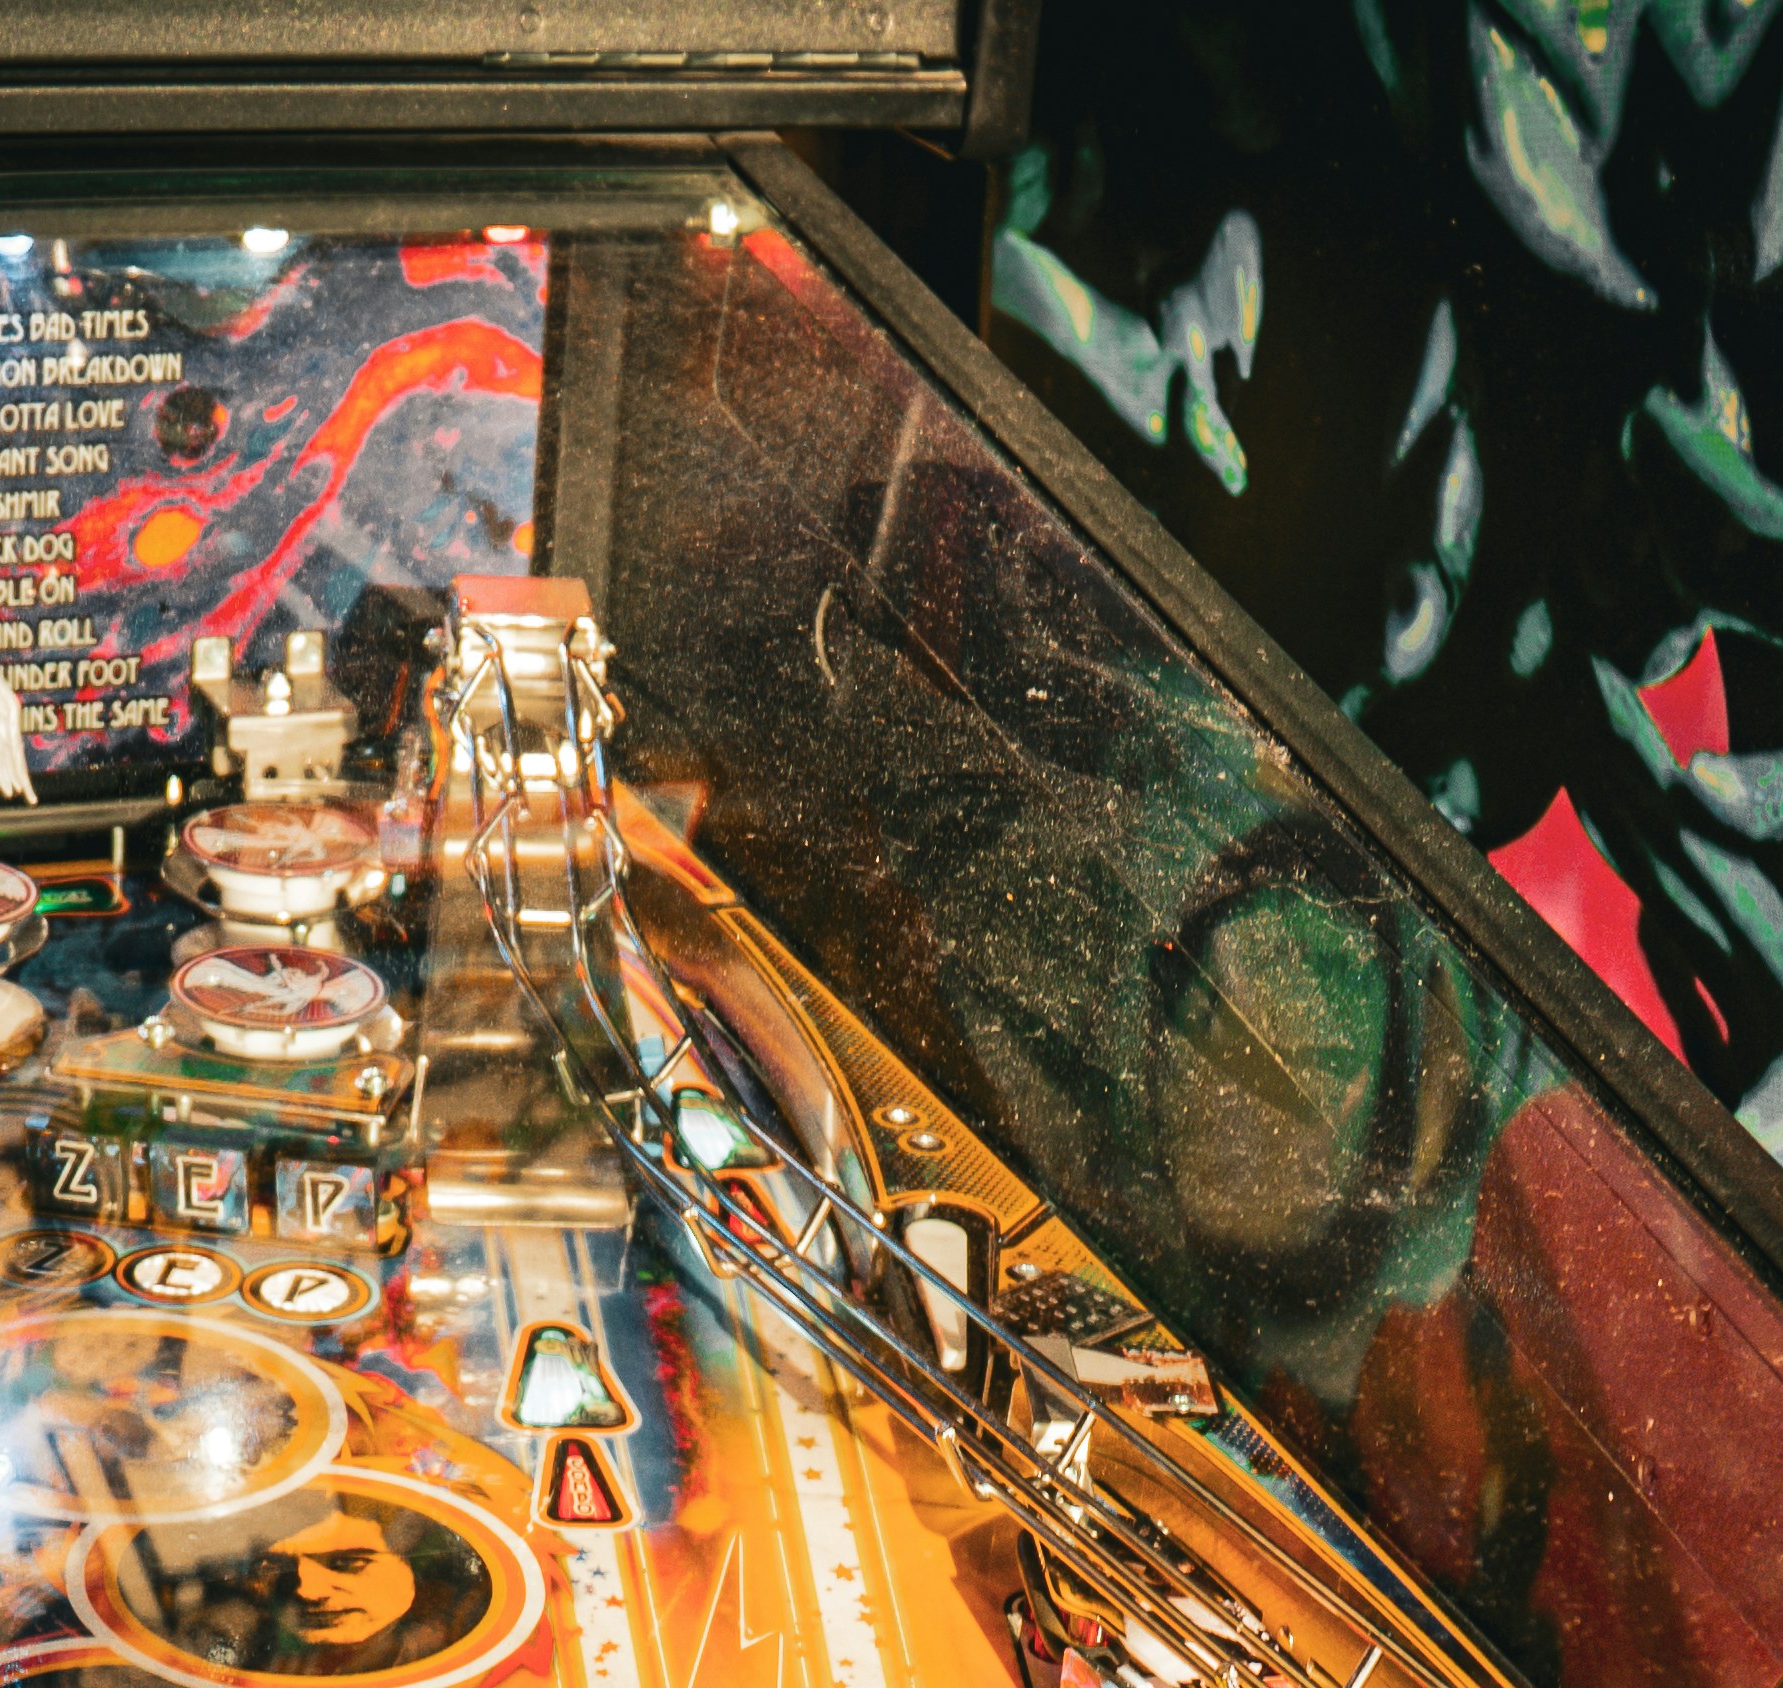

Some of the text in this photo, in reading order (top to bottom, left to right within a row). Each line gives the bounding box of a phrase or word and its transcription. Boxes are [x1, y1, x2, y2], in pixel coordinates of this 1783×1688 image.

[30, 312, 76, 342] BAD
[82, 309, 149, 340] TIMES
[43, 352, 183, 386] BREAKDOWN
[65, 398, 125, 429] LOVE
[45, 443, 109, 475] SONG
[23, 532, 74, 562] DOG
[40, 574, 75, 604] ON
[38, 617, 97, 647] ROLL
[78, 657, 140, 687] FOOT
[63, 702, 105, 731] THE
[111, 698, 170, 728] SAME
[566, 1455, 596, 1517] COMBO
